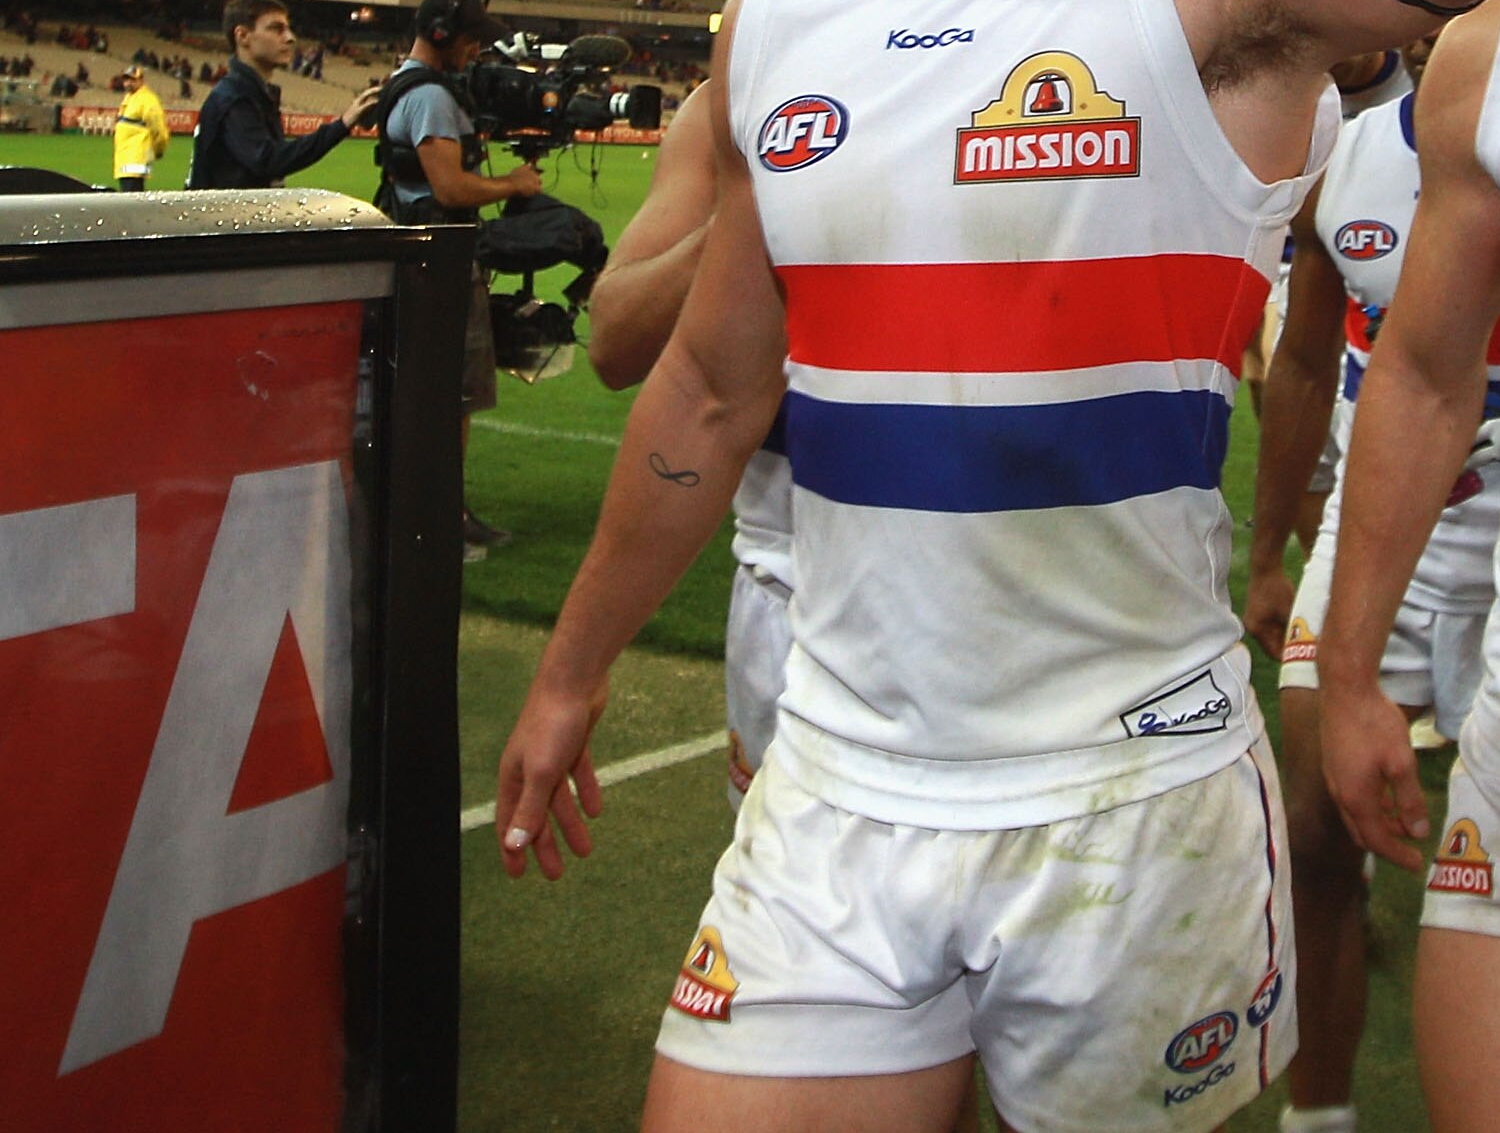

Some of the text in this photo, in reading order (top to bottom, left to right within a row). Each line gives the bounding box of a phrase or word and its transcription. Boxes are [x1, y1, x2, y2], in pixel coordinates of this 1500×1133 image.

[886, 27, 976, 51] KooGa
[760, 110, 840, 156] AFL
[1338, 229, 1394, 251] AFL
[1173, 1020, 1233, 1068] AFL
